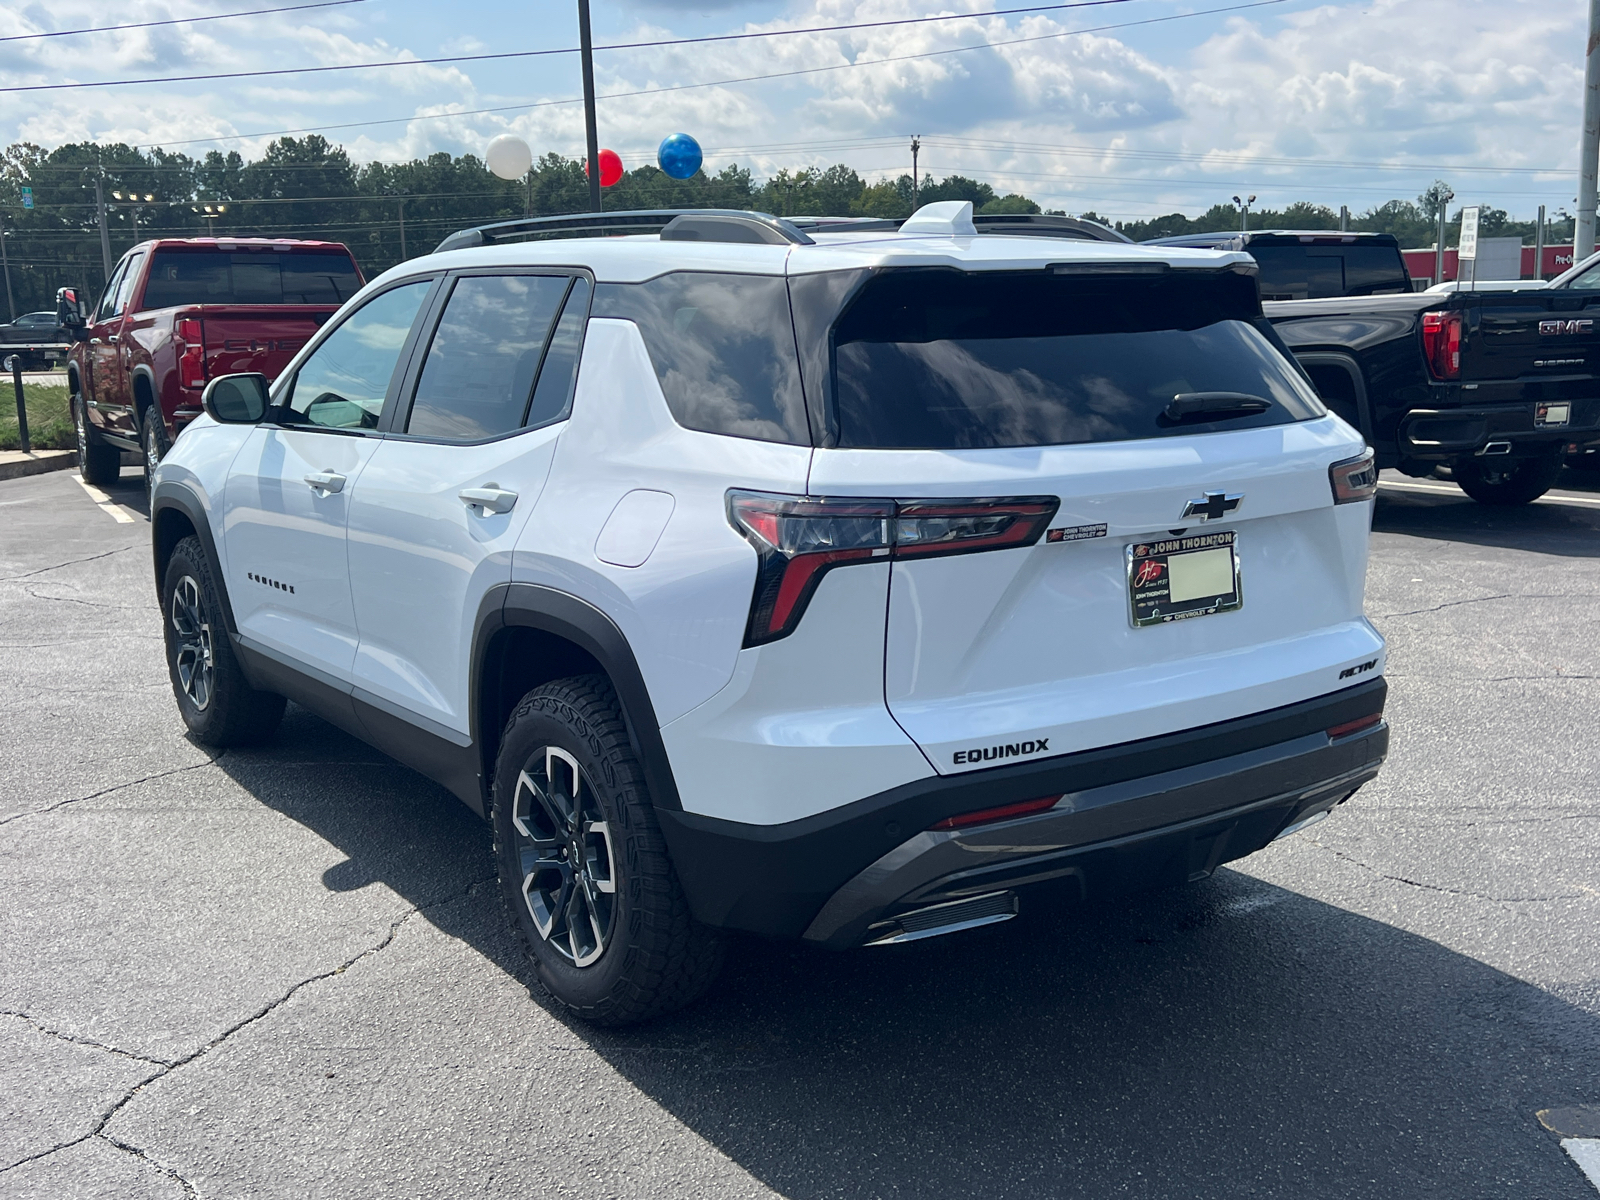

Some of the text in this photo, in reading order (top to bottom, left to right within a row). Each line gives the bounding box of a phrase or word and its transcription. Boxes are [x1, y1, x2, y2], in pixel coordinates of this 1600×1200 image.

[1539, 320, 1593, 336] GMC
[1063, 527, 1078, 535] JOHN
[1079, 524, 1107, 533] THORNTON
[1063, 532, 1096, 540] CHEVROLET
[1153, 541, 1180, 553] JOHN
[1181, 533, 1232, 549] THORNTON
[247, 572, 295, 595] EQUINOX
[1174, 610, 1206, 620] CHEVROLET
[1338, 658, 1379, 680] ACTIV
[953, 738, 1049, 765] EQUINOX
